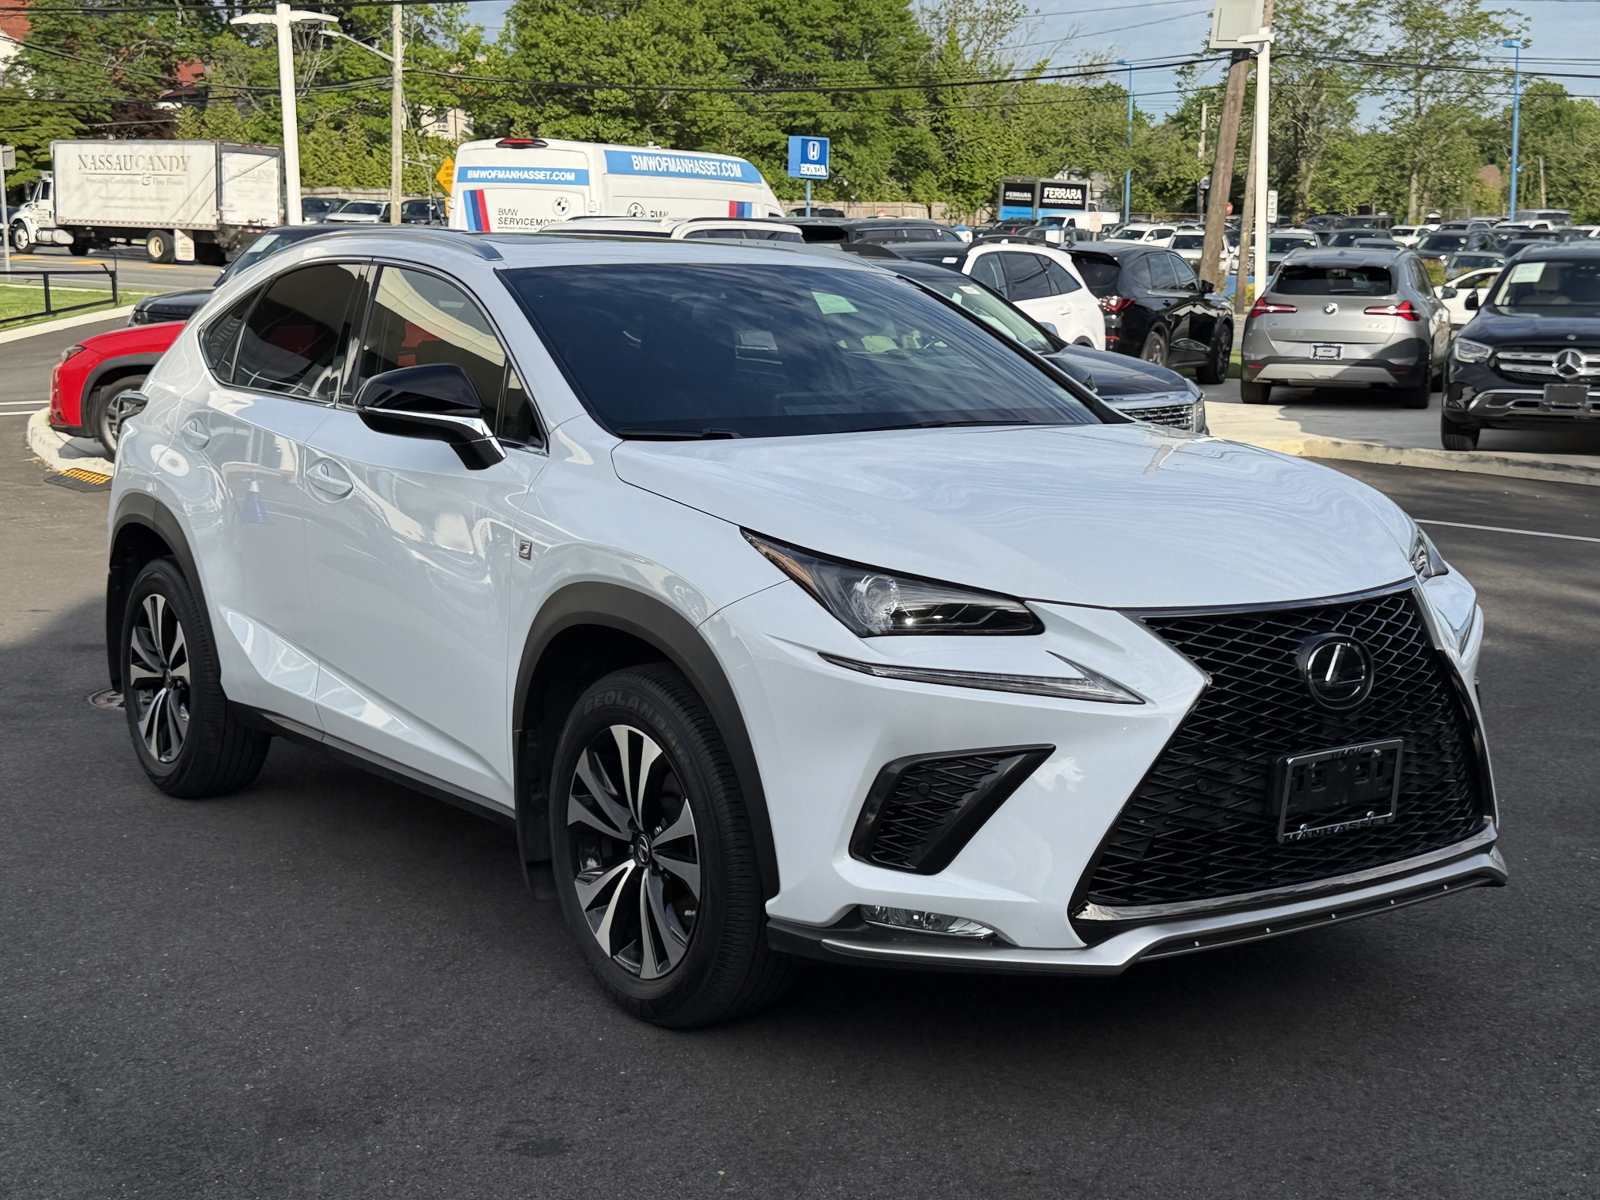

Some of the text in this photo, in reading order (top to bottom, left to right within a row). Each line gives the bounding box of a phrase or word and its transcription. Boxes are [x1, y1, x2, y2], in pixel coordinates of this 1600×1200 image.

[78, 154, 190, 172] NASSAU CANDY
[631, 155, 742, 177] BMWOFMANHASSET.COM
[467, 169, 575, 181] BMWOFMANHASSET.COM
[1043, 187, 1082, 199] FERRARA
[498, 208, 518, 216] BMW
[1284, 818, 1389, 842] MANHASSET
